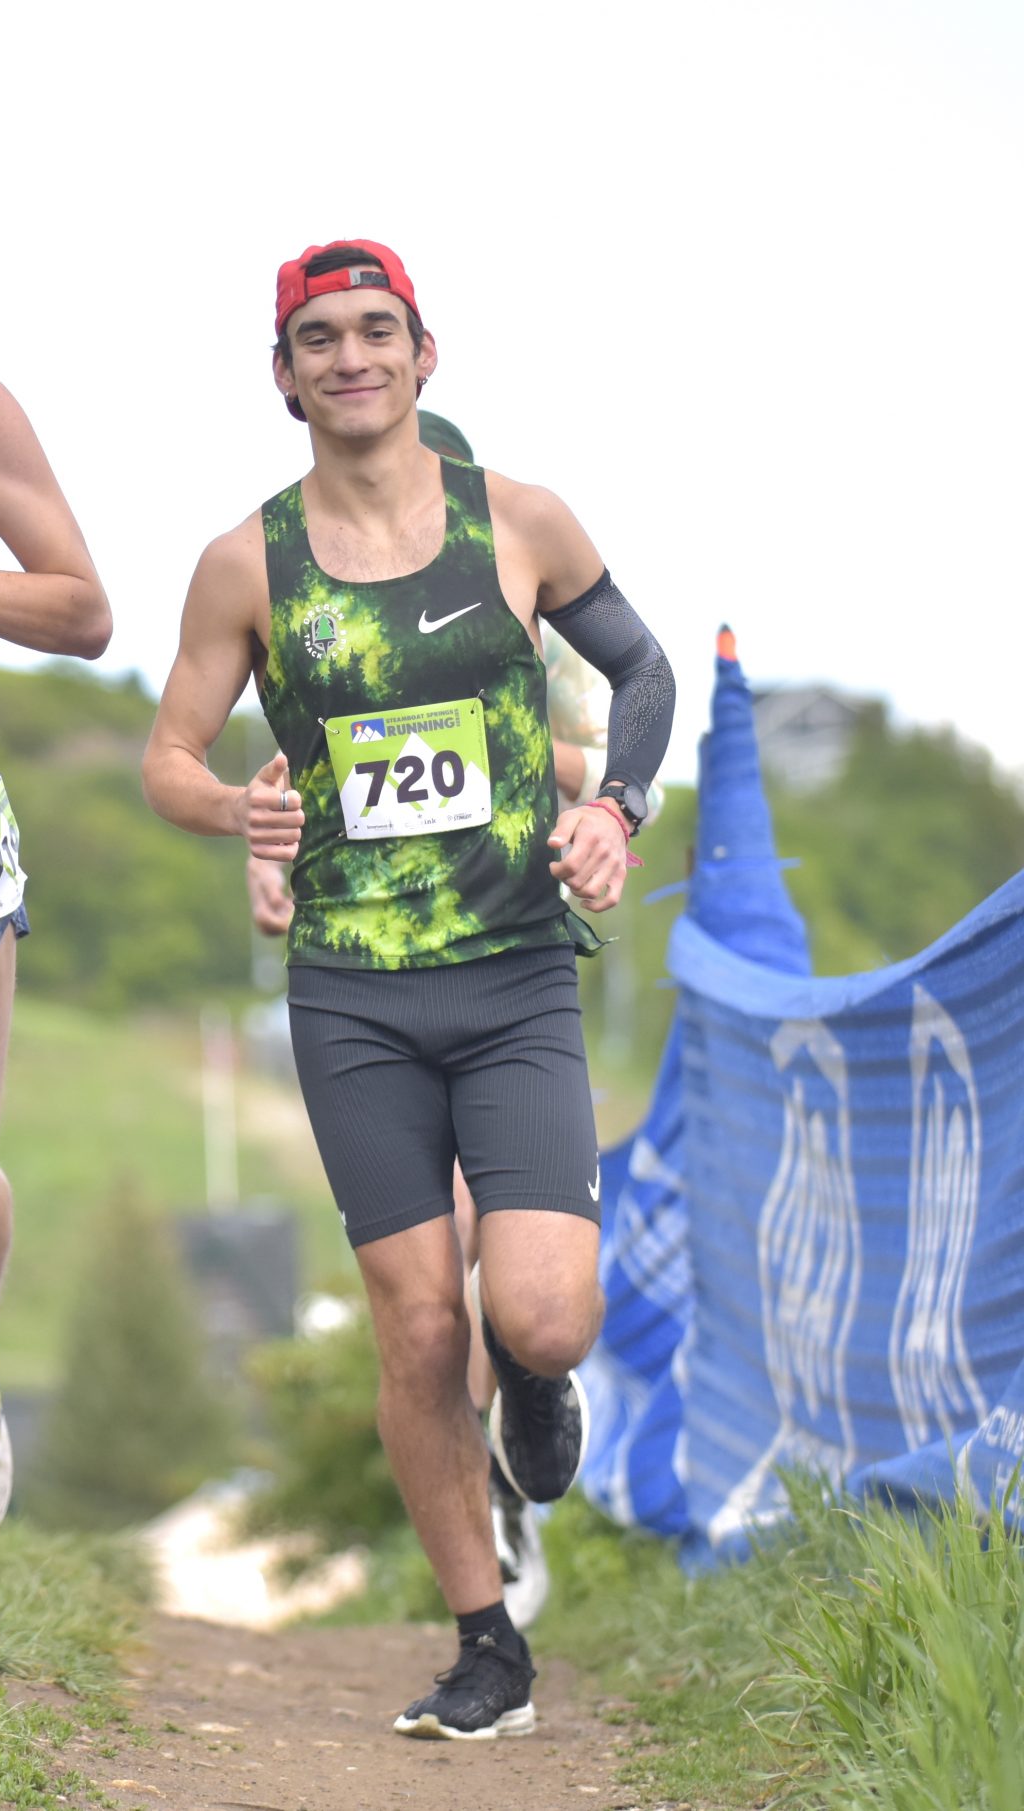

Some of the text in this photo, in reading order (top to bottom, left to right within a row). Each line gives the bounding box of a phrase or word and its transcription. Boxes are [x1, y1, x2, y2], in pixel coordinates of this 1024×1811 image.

[303, 603, 345, 625] OREGON
[304, 633, 322, 660] TRACK
[386, 709, 454, 724] STEAMBOAT SPRINGS
[386, 717, 455, 737] RUNNING
[354, 749, 465, 807] 720
